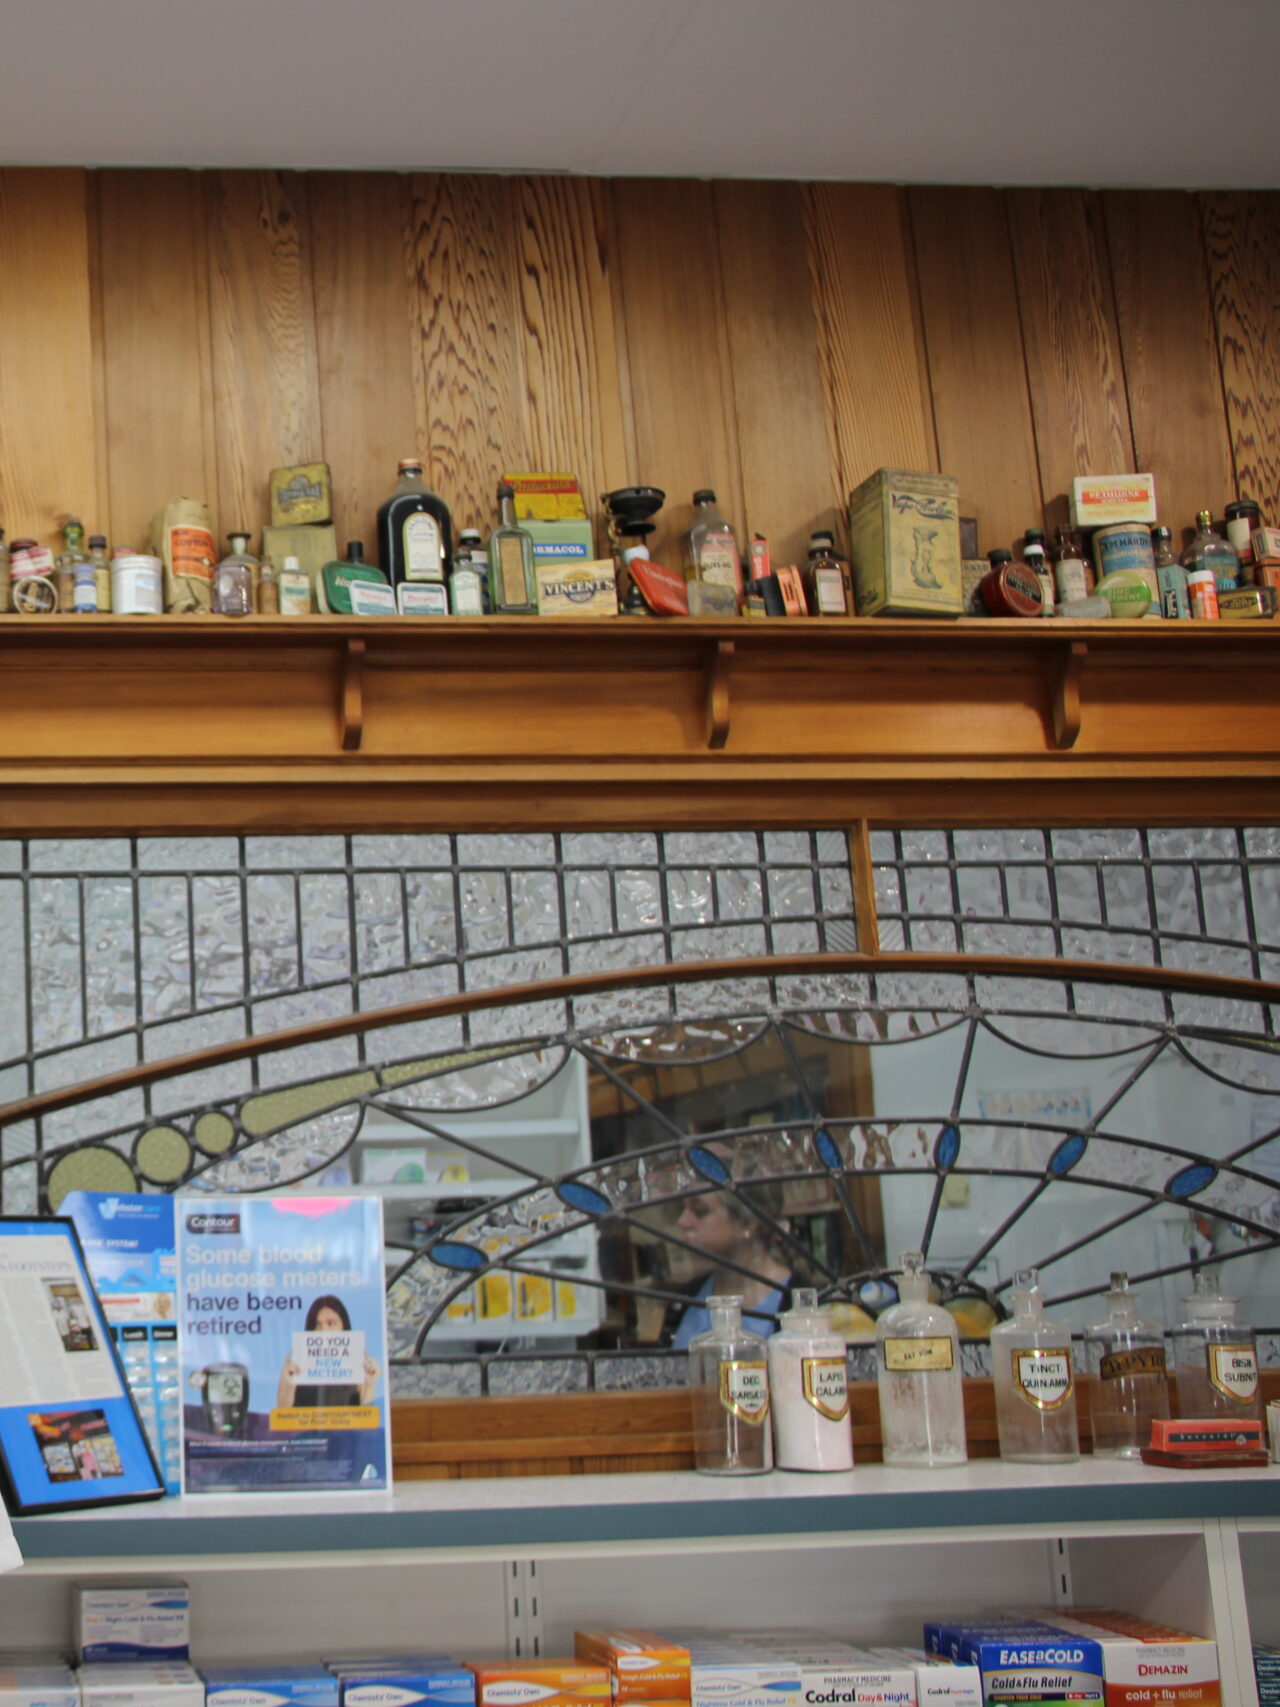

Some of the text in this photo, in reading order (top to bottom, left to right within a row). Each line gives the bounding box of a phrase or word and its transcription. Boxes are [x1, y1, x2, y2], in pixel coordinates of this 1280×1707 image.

[533, 545, 584, 554] ORMACOL
[544, 577, 616, 596] VINCENT'S
[190, 1215, 235, 1228] Contour
[186, 1243, 325, 1265] Some blood
[186, 1268, 362, 1292] glucose meters
[187, 1293, 302, 1311] have been
[187, 1316, 262, 1335] retired
[306, 1337, 350, 1347] DO YOU
[308, 1348, 349, 1358] NEED A
[315, 1359, 342, 1368] NEW
[307, 1369, 353, 1378] METER?
[823, 1675, 892, 1684] PHARMACY MEDICINE
[1041, 1676, 1073, 1688] Relief
[805, 1689, 856, 1704] Codral
[1125, 1690, 1150, 1700] cold
[1162, 1689, 1176, 1699] flu
[1178, 1688, 1203, 1699] relief
